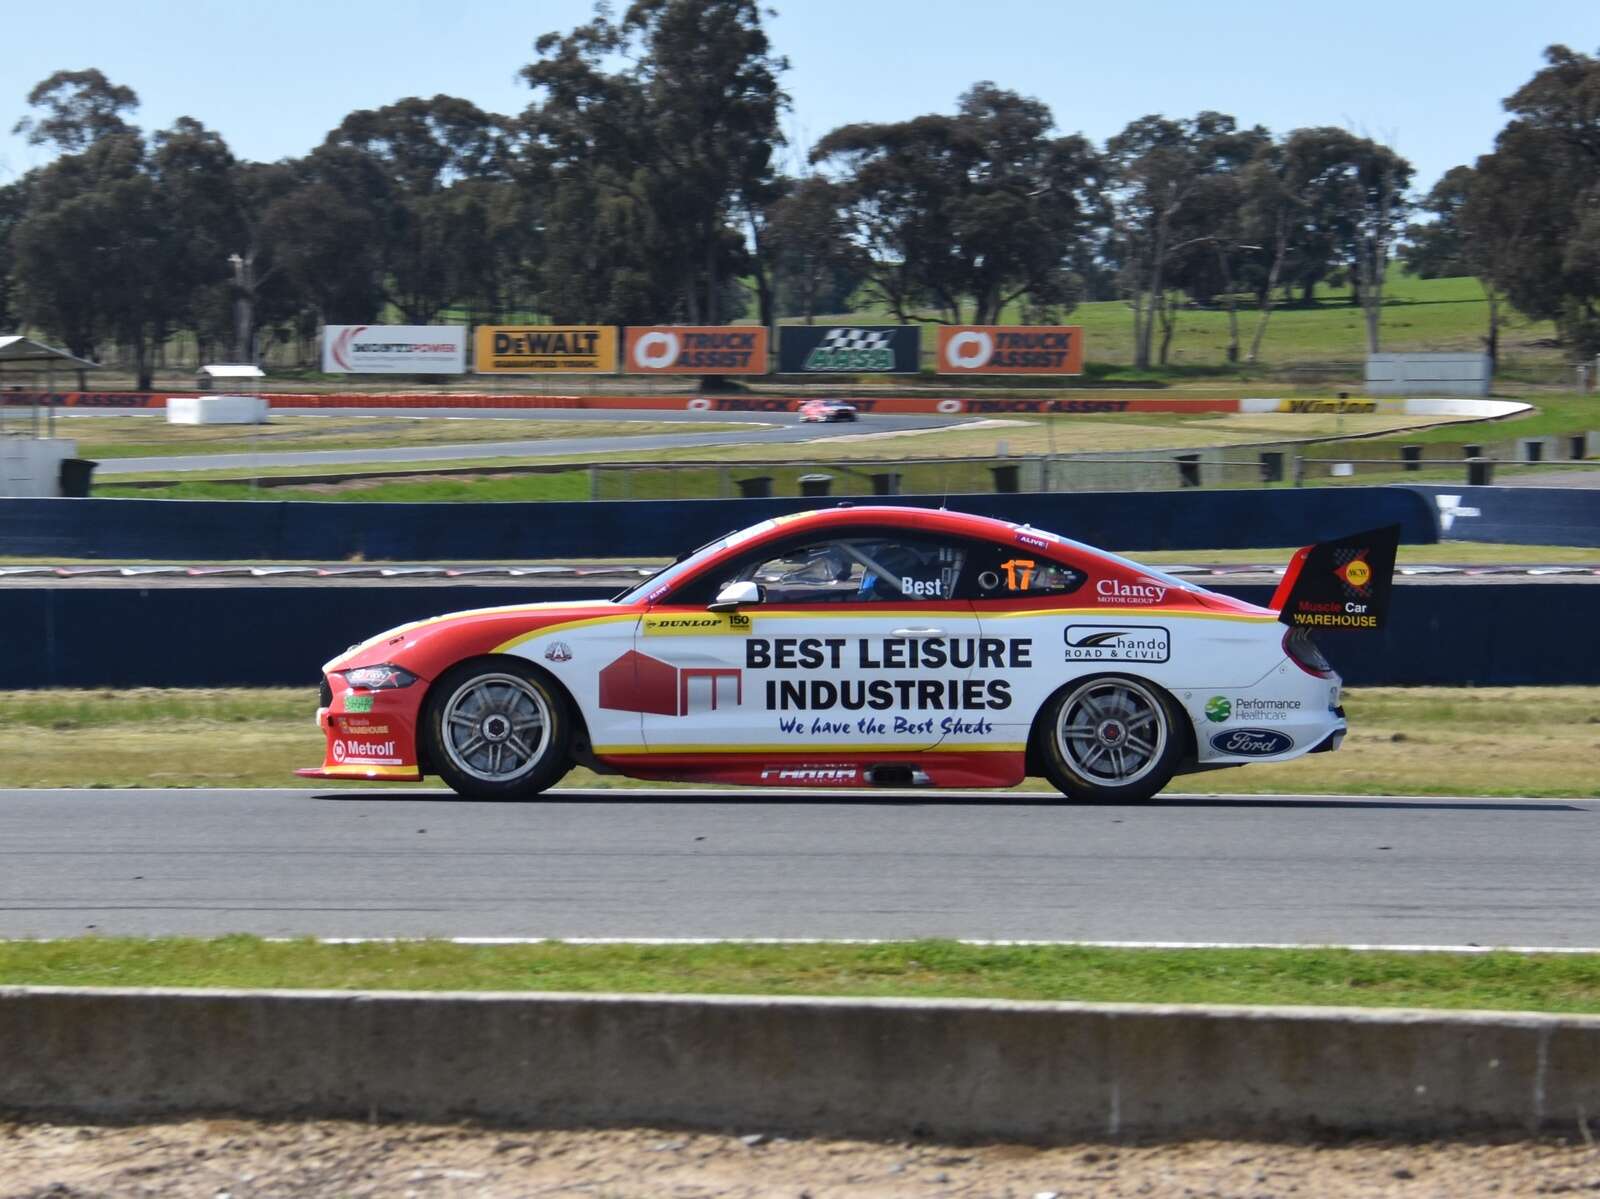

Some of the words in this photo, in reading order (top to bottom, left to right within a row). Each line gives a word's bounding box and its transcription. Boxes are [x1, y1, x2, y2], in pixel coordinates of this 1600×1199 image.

[684, 333, 755, 349] TRUCK
[996, 333, 1072, 349] TRUCK
[677, 351, 751, 367] ASSIST
[989, 351, 1067, 368] ASSIST
[1020, 536, 1044, 547] ALIVE
[1000, 559, 1035, 590] 17
[901, 577, 941, 595] Best
[1096, 579, 1166, 602] Clancy
[1299, 602, 1341, 612] Muscle
[1345, 602, 1367, 613] Car
[658, 619, 721, 627] DUNLOP
[729, 615, 749, 625] 150
[1294, 614, 1377, 627] WAREHOUSE
[746, 638, 846, 669] BEST
[859, 638, 1033, 669] LEISURE
[1065, 650, 1102, 658] ROAD
[1110, 650, 1118, 658] &
[1125, 650, 1162, 659] CIVIL
[766, 679, 1012, 711] INDUSTRIES
[1236, 698, 1301, 709] Performance
[1236, 711, 1287, 721] Healthcare
[779, 717, 804, 734] We
[811, 717, 851, 734] have
[857, 717, 886, 734] the
[893, 716, 934, 734] Best
[940, 717, 993, 735] Sheds
[347, 740, 394, 756] Metroll
[1226, 731, 1278, 751] Ford
